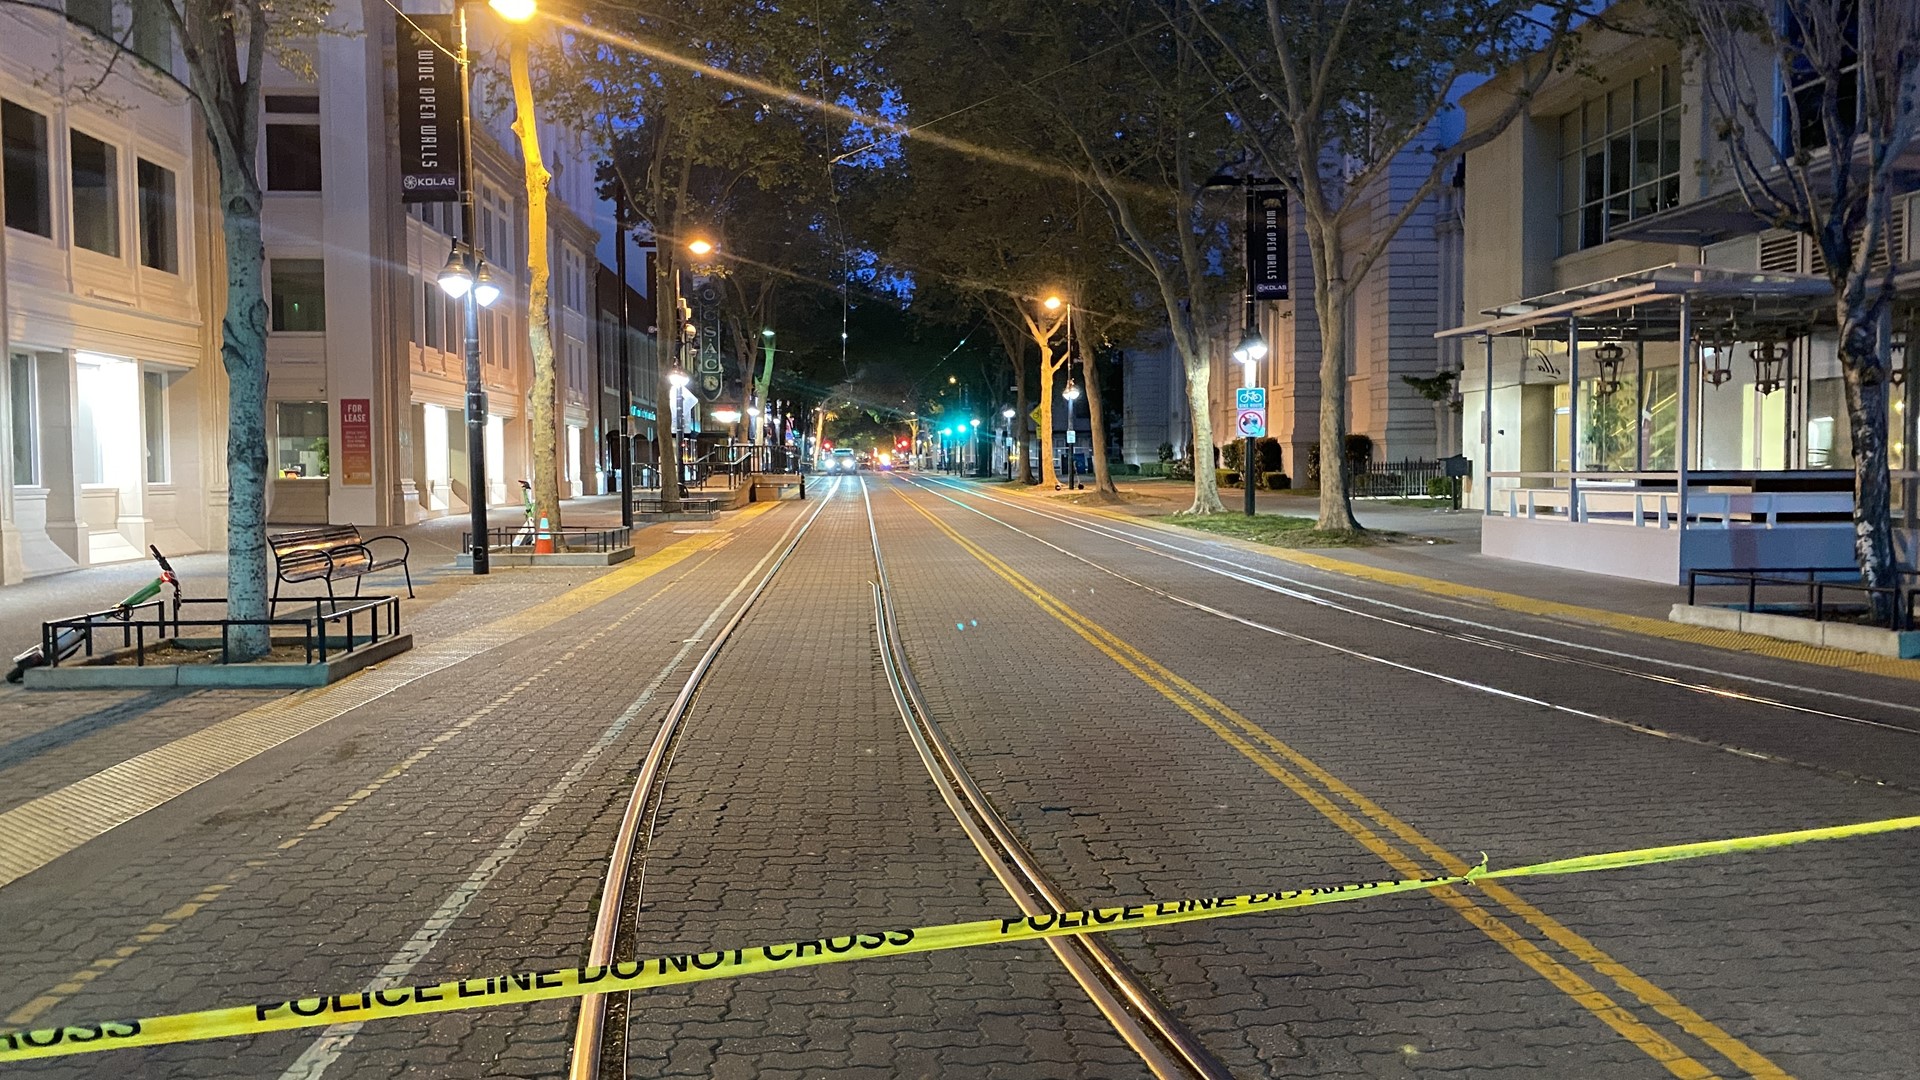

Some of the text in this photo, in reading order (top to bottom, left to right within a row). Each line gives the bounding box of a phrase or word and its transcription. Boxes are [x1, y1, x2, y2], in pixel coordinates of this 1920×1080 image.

[417, 50, 438, 168] WIDE OPEN WALLS
[417, 176, 456, 187] KOLAS
[1266, 210, 1278, 280] WIDE OPEN WALLS
[347, 404, 362, 413] FOR
[344, 414, 366, 422] LEASE
